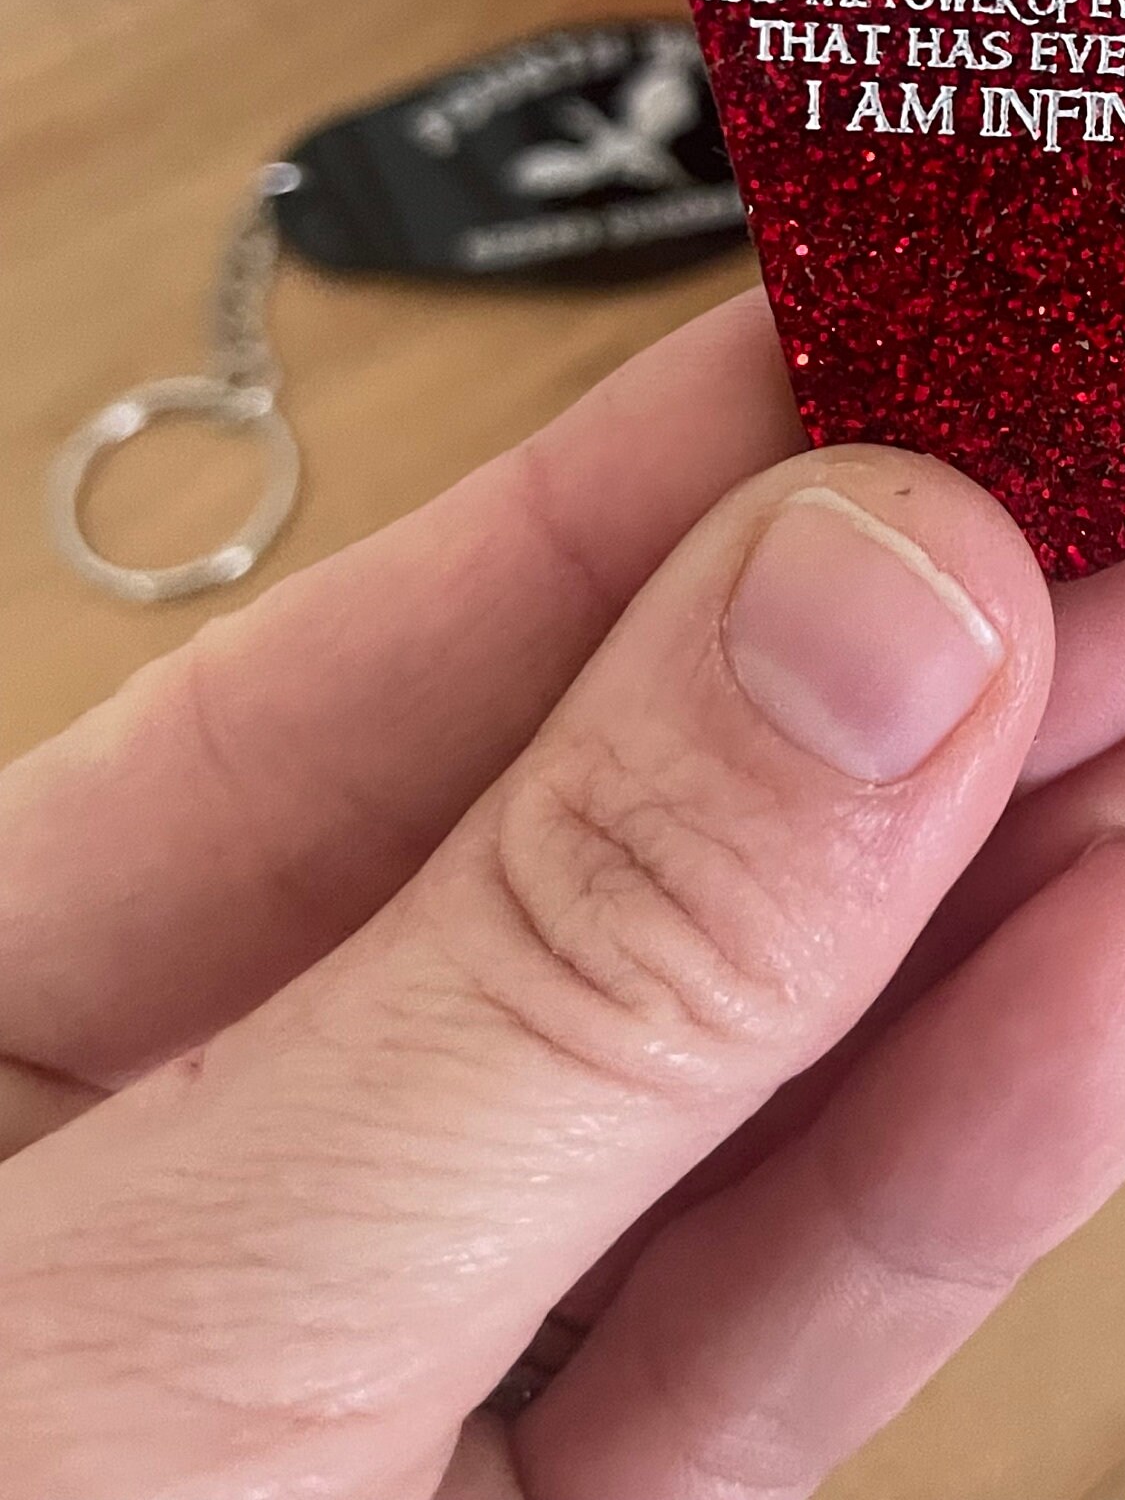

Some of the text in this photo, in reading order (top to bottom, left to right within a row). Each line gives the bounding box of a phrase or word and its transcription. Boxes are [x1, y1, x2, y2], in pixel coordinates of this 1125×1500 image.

[749, 17, 891, 66] THAT
[906, 27, 1013, 71] HAS
[804, 79, 823, 131] I
[845, 81, 957, 136] AM
